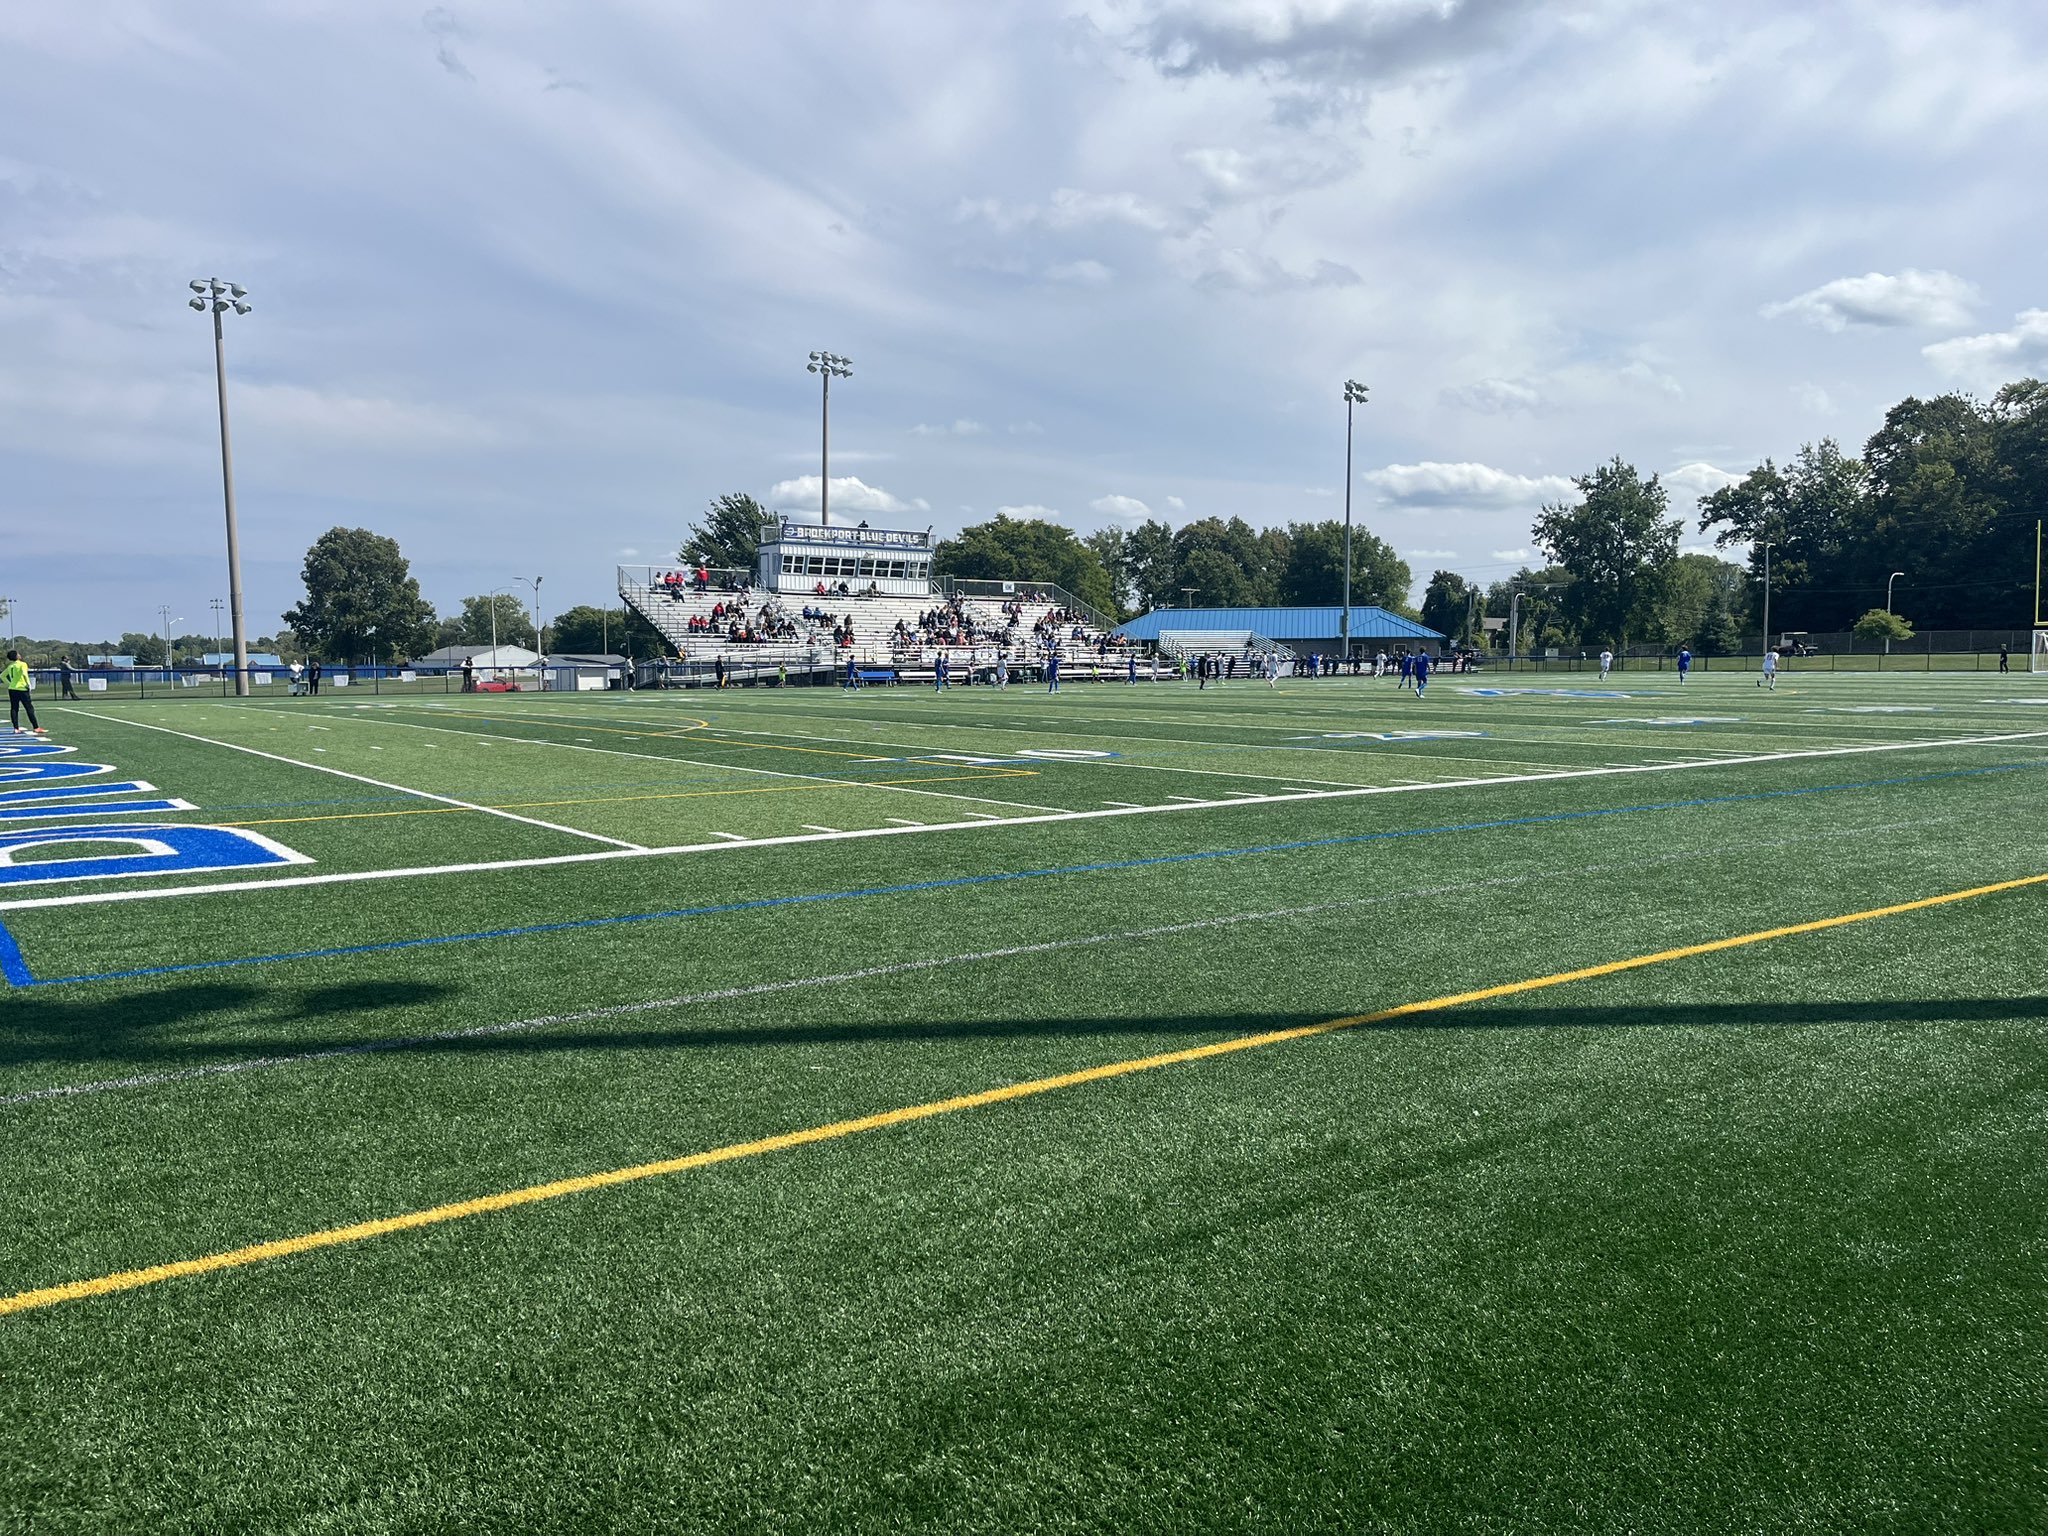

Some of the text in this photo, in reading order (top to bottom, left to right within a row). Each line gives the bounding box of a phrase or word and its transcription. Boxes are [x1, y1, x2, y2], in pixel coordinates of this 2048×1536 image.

[796, 527, 919, 544] BROCKPORT BLUE DEVILS
